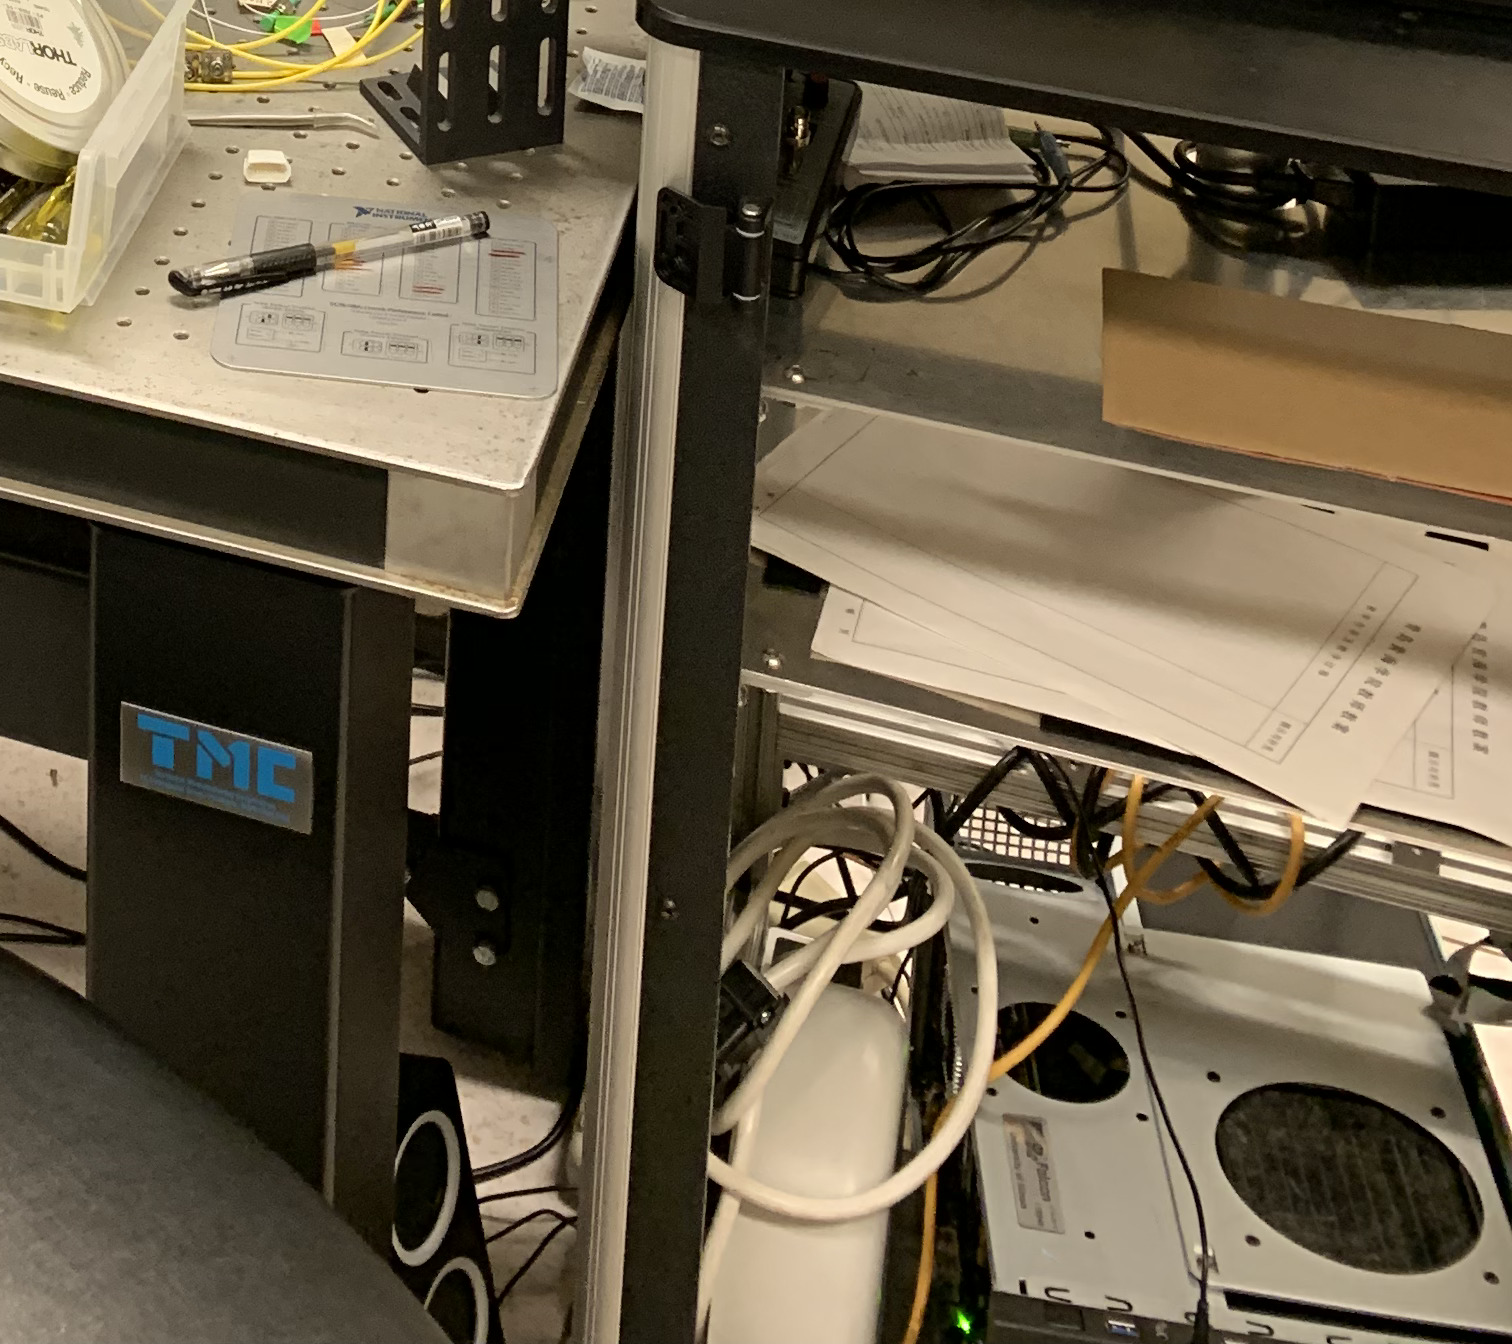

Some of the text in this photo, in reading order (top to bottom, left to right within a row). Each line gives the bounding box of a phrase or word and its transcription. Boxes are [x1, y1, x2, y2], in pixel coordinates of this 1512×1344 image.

[33, 82, 67, 101] Reuse
[68, 66, 92, 96] Reduce
[376, 208, 428, 219] NATIONAL
[136, 713, 296, 803] TMC
